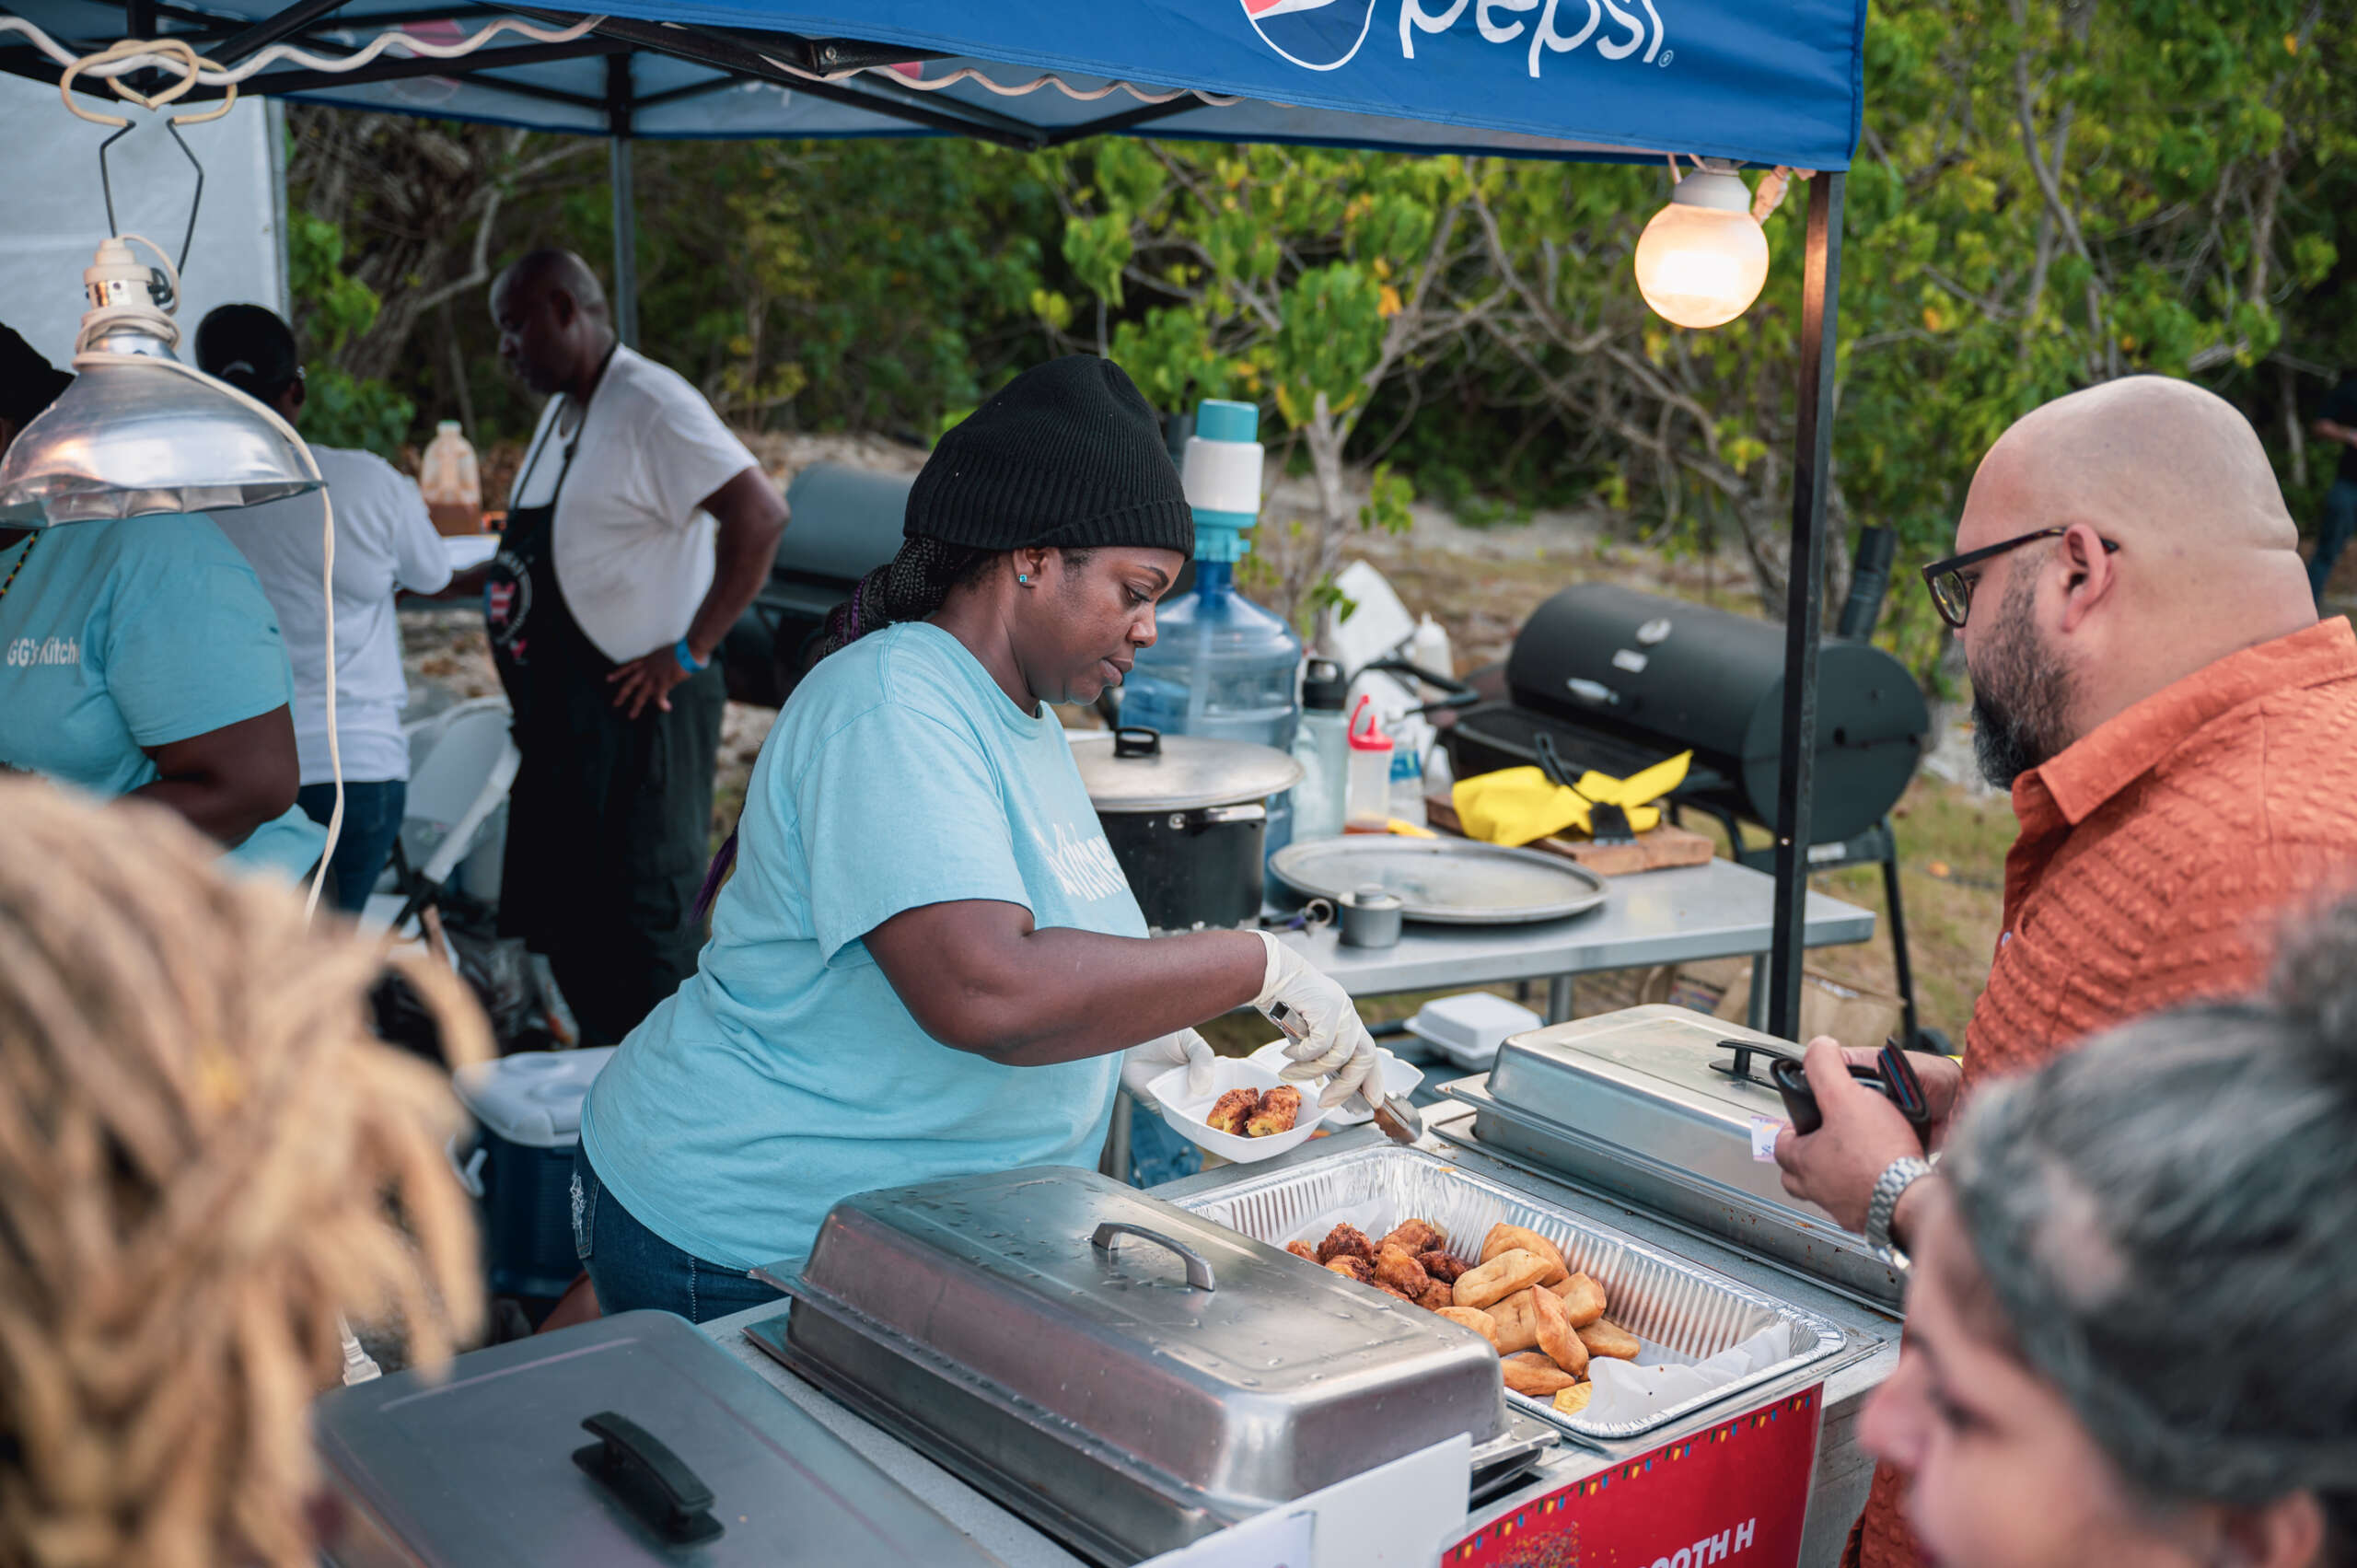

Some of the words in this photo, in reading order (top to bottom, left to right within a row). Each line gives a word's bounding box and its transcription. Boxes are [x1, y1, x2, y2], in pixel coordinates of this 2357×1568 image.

[7, 638, 39, 667] GG's
[1638, 1528, 1731, 1568] OTH
[1734, 1517, 1756, 1553] H
